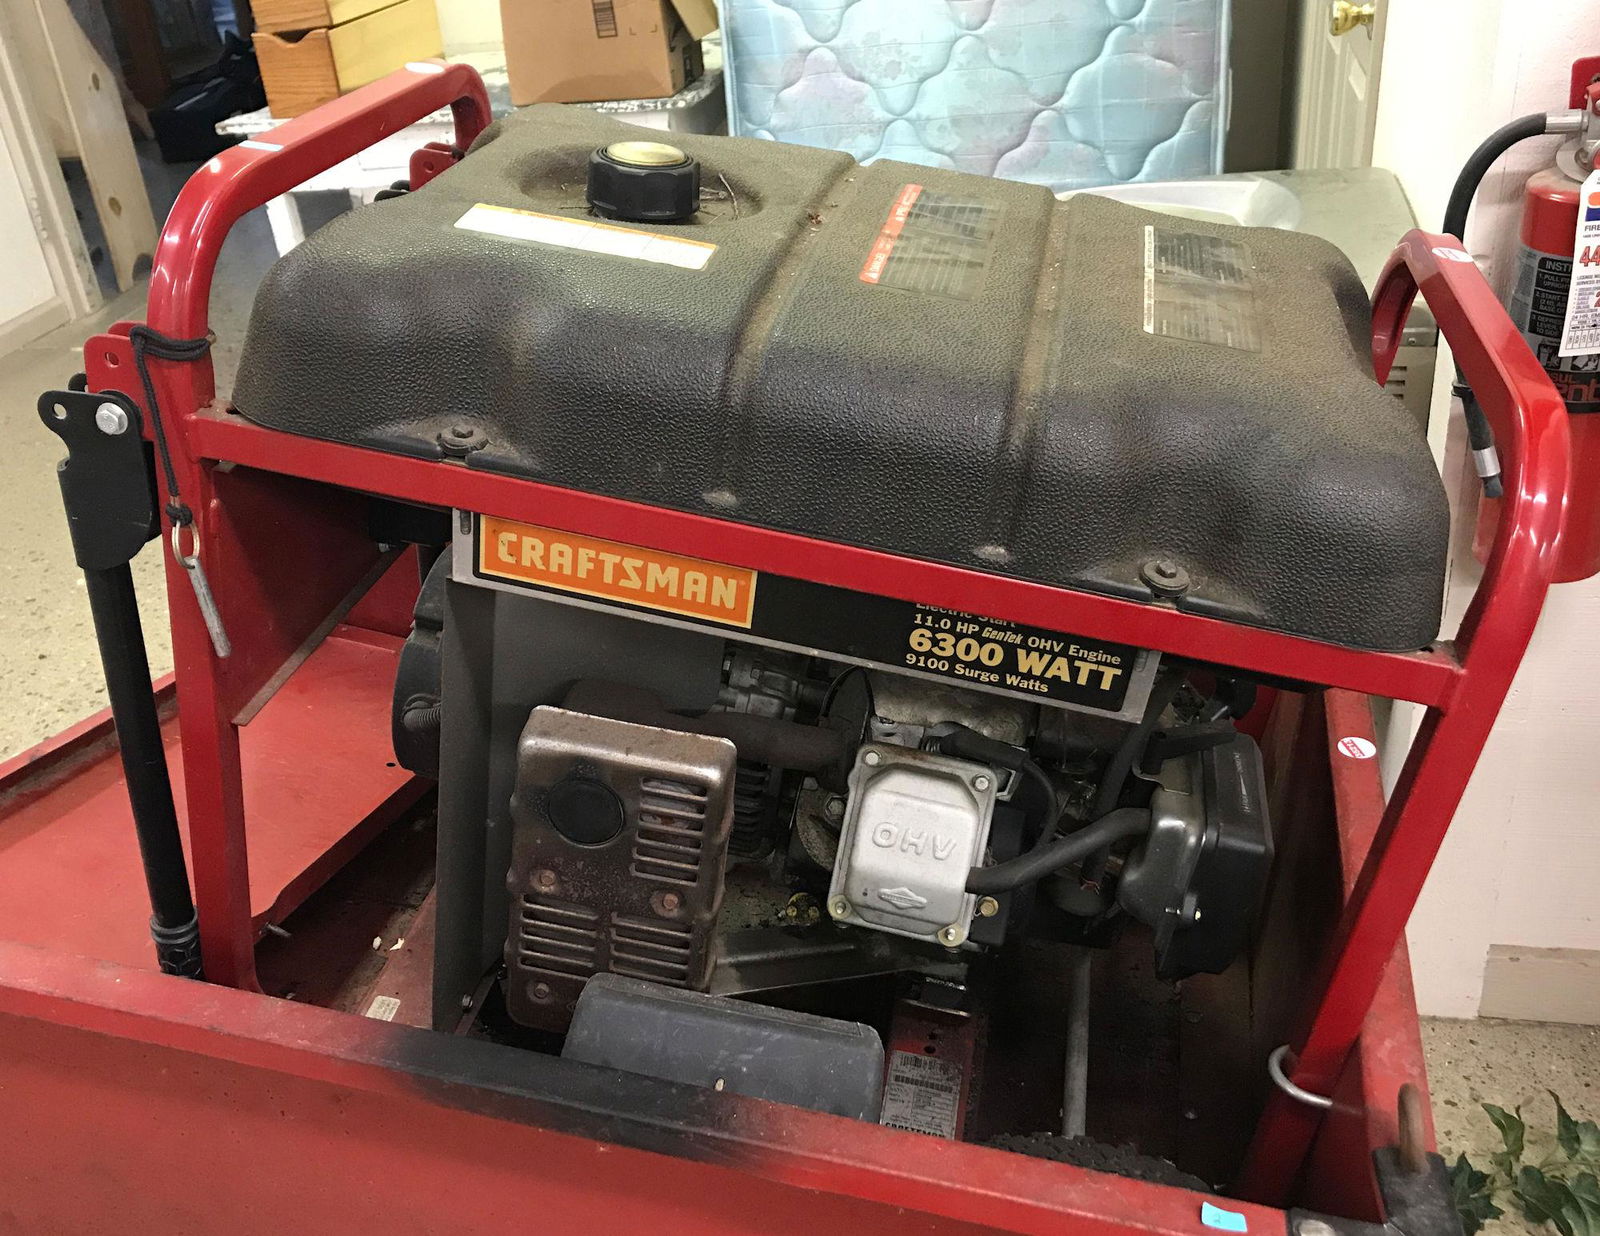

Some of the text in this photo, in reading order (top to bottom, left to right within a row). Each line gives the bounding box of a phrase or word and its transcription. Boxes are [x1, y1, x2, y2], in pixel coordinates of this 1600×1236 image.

[497, 531, 738, 610] CRAFTSMAN
[908, 628, 1123, 691] 6300 WATT
[914, 613, 1122, 666] 11.0 HP GenTek OHV Engine
[905, 653, 1049, 693] 9100 Surge Watts
[871, 821, 957, 861] OHV
